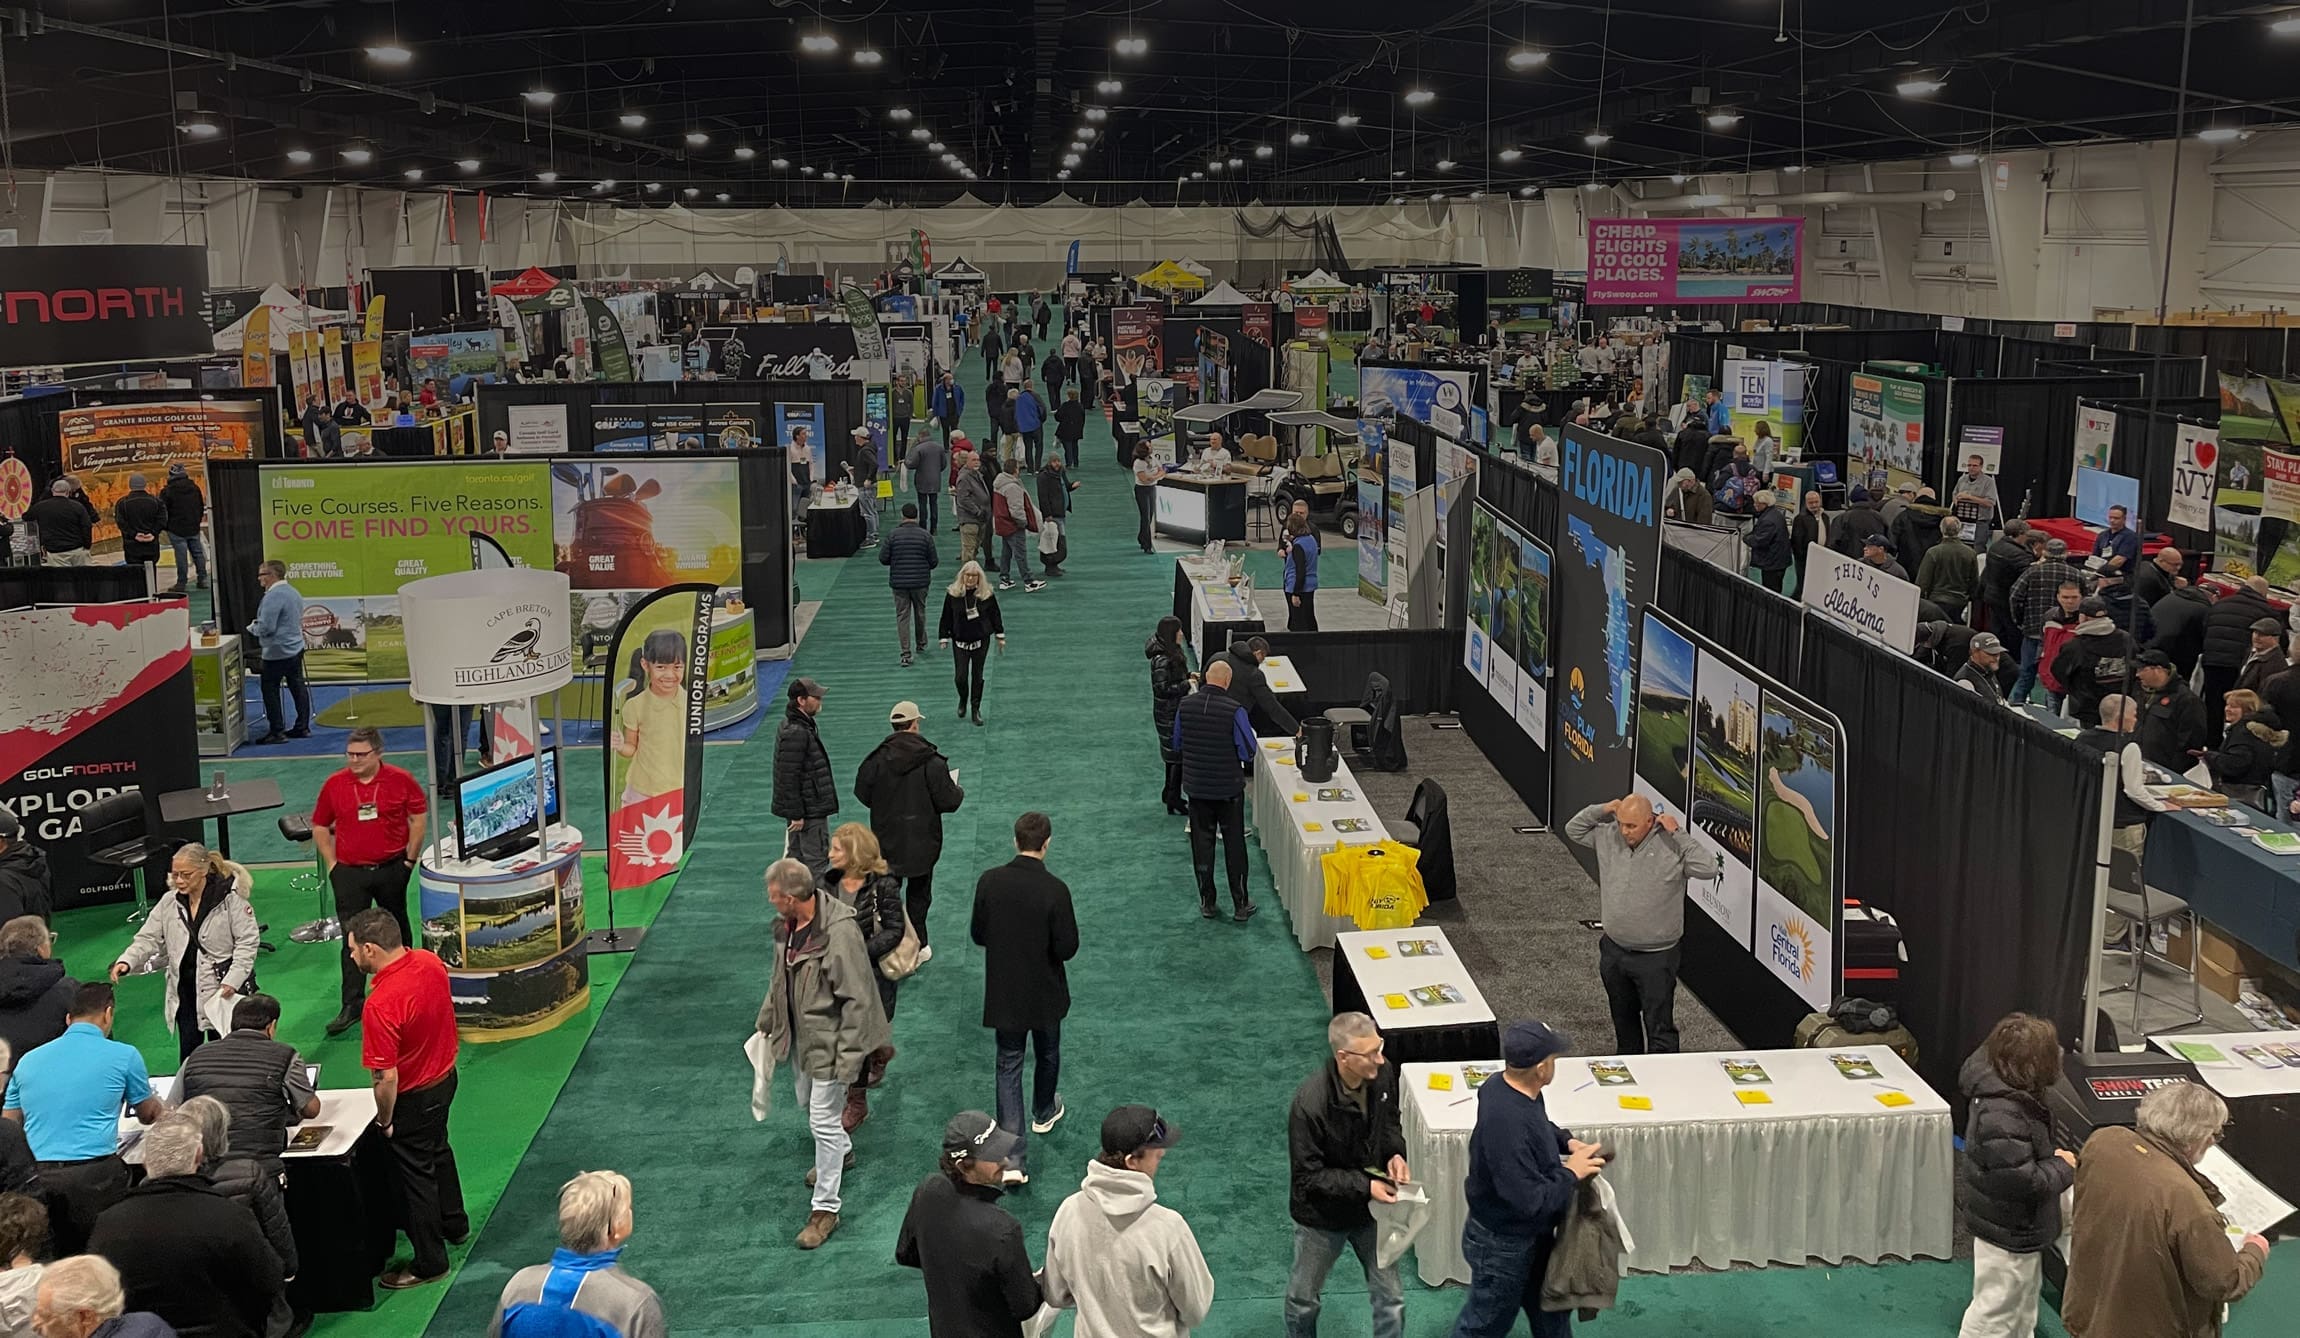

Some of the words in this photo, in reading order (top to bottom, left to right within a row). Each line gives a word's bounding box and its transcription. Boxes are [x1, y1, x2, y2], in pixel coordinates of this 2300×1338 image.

[1595, 225, 1657, 239] CHEAP
[1595, 239, 1668, 253] FLIGHTS
[1594, 254, 1618, 267] TO
[1621, 253, 1668, 267] COOL
[1593, 268, 1665, 282] PLACES.
[0, 286, 184, 324] NORTH
[1592, 290, 1658, 300] FlySwoop.com
[1740, 375, 1765, 394] TEN
[103, 417, 136, 426] GRANITE
[137, 415, 162, 423] RIDGE
[164, 414, 186, 422] GOLF
[594, 420, 646, 430] GOLFCARD
[2182, 438, 2194, 465] I
[73, 453, 129, 472] Niagara
[2266, 455, 2287, 472] STAY.
[2287, 461, 2300, 475] PL
[464, 472, 535, 485] toronto.ca/golf
[1563, 437, 1653, 528] FLORIDA
[2175, 467, 2214, 500] NY
[272, 499, 313, 516] Five
[320, 498, 404, 515] Courses.
[411, 496, 452, 512] Five
[456, 494, 543, 511] Reasons.
[273, 520, 355, 541] COME
[364, 517, 429, 538] FIND
[441, 515, 538, 536] YOURS.
[289, 562, 337, 571] SOMETHING
[398, 559, 424, 568] GREAT
[588, 554, 615, 563] GREAT
[589, 562, 615, 571] VALUE
[301, 569, 344, 579] EVERYONE
[394, 567, 427, 577] QUALITY
[1834, 563, 1864, 581] THIS
[1866, 575, 1880, 599] IS
[486, 607, 514, 628] CAPE
[515, 604, 553, 617] BRETON
[1824, 588, 1885, 635] Alabama
[694, 593, 712, 676] PROGRAMS
[455, 660, 544, 683] HIGHLANDS
[547, 651, 571, 669] LINKS
[689, 680, 704, 735] JUNIOR
[1577, 715, 1596, 743] PLAY
[1563, 720, 1595, 763] FLORIDA
[23, 760, 137, 782] GOLFNORTH
[0, 785, 140, 818] XPLO
[38, 816, 83, 840] GA
[80, 882, 132, 894] GOLFNORTH
[1770, 923, 1800, 961] Central
[1771, 943, 1801, 979] Florida
[2092, 1077, 2187, 1092] SHOWTE
